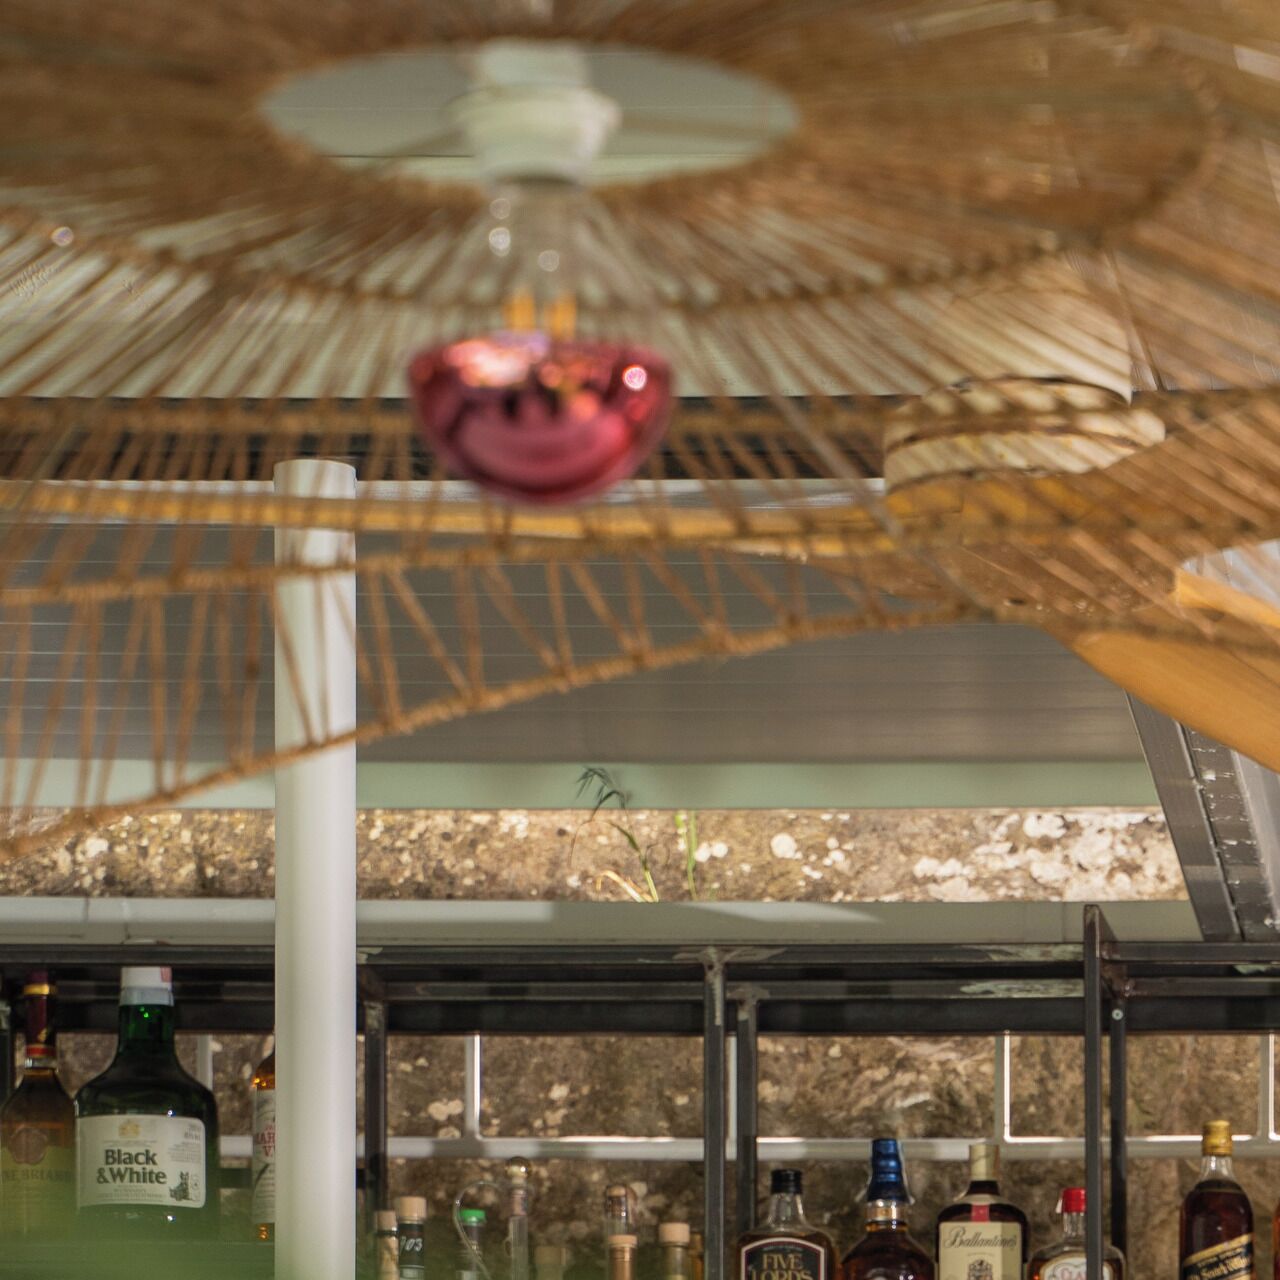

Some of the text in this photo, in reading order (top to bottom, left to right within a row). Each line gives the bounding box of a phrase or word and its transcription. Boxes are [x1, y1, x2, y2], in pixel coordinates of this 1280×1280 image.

[104, 1149, 157, 1167] Black
[96, 1168, 168, 1186] &White
[943, 1226, 1018, 1252] Ballantine's
[763, 1253, 803, 1270] FIVE
